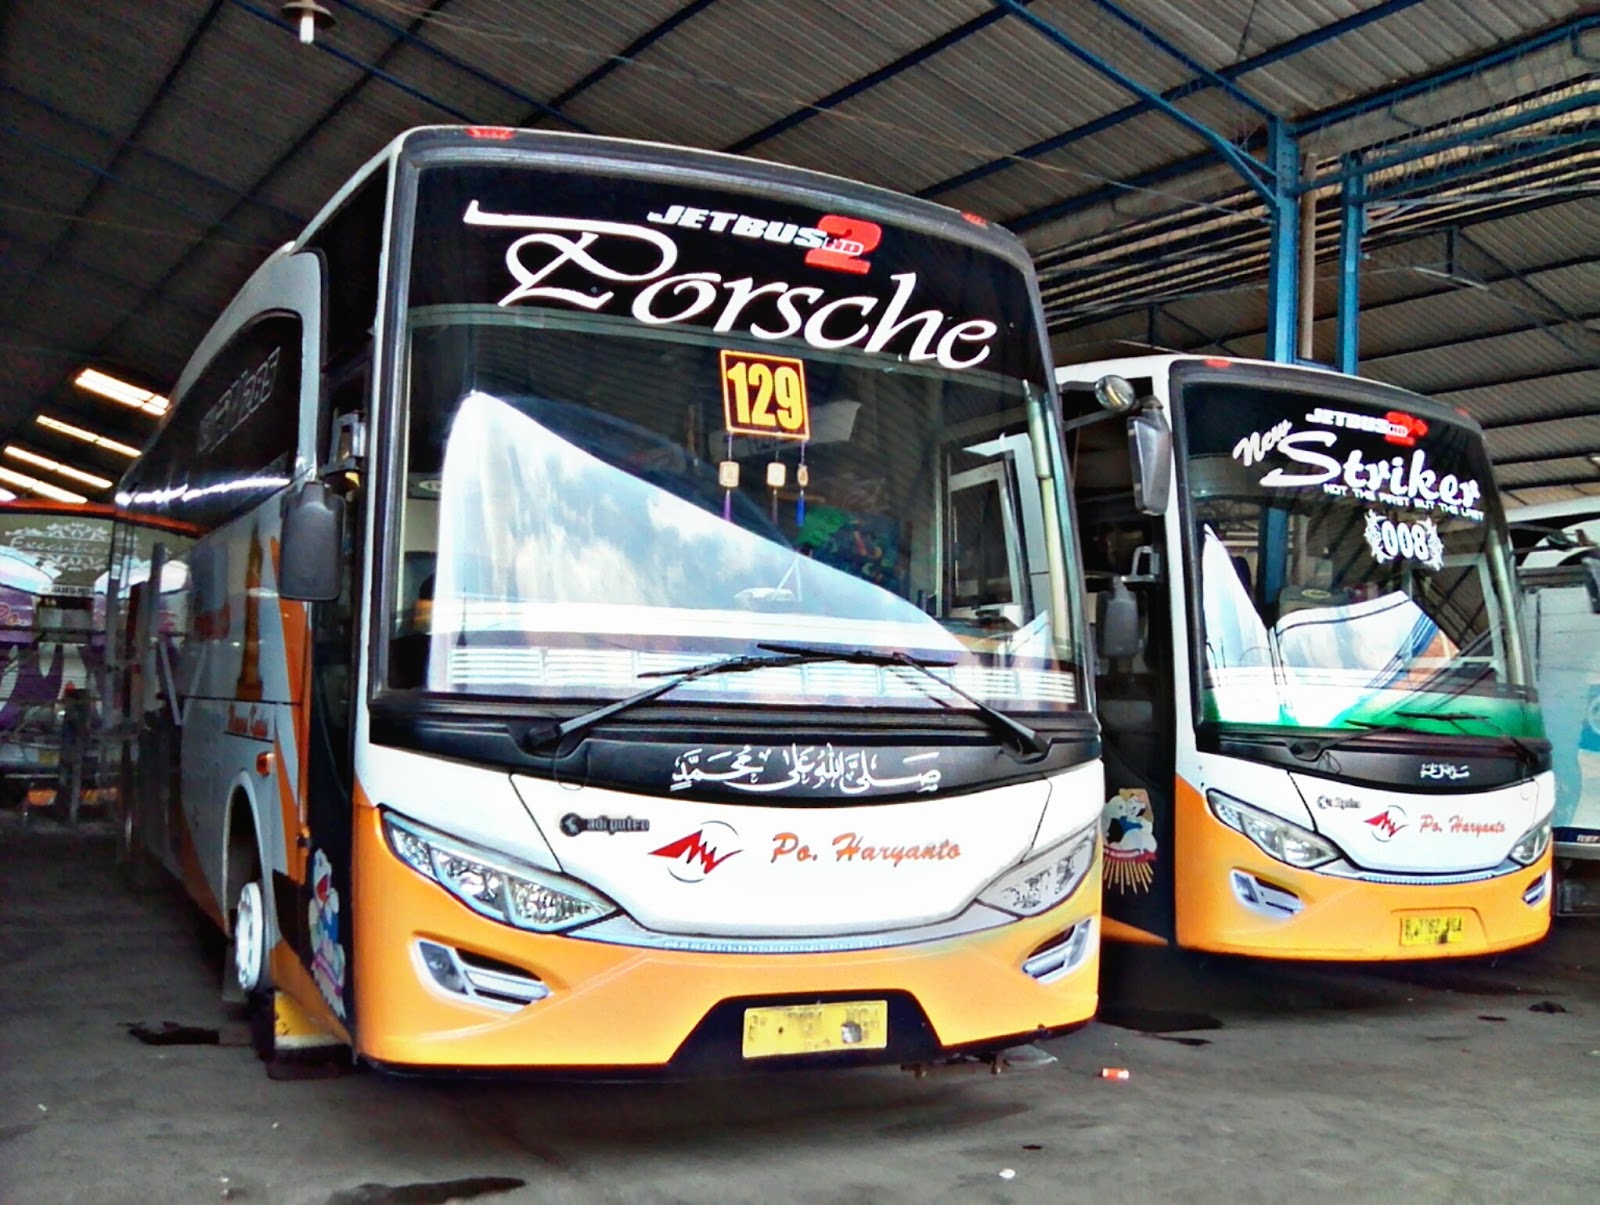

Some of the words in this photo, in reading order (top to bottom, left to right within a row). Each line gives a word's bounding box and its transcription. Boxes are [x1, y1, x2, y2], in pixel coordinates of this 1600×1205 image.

[646, 205, 828, 249] JETBUS
[463, 199, 998, 369] Porsche
[727, 360, 803, 430] 129
[1305, 408, 1392, 435] JETBUS
[1259, 430, 1482, 508] Striker
[1323, 483, 1348, 496] NOT
[1381, 520, 1430, 561] 008
[1448, 814, 1505, 838] Haryanto
[771, 832, 818, 863] Po.
[832, 832, 961, 867] Haryanto
